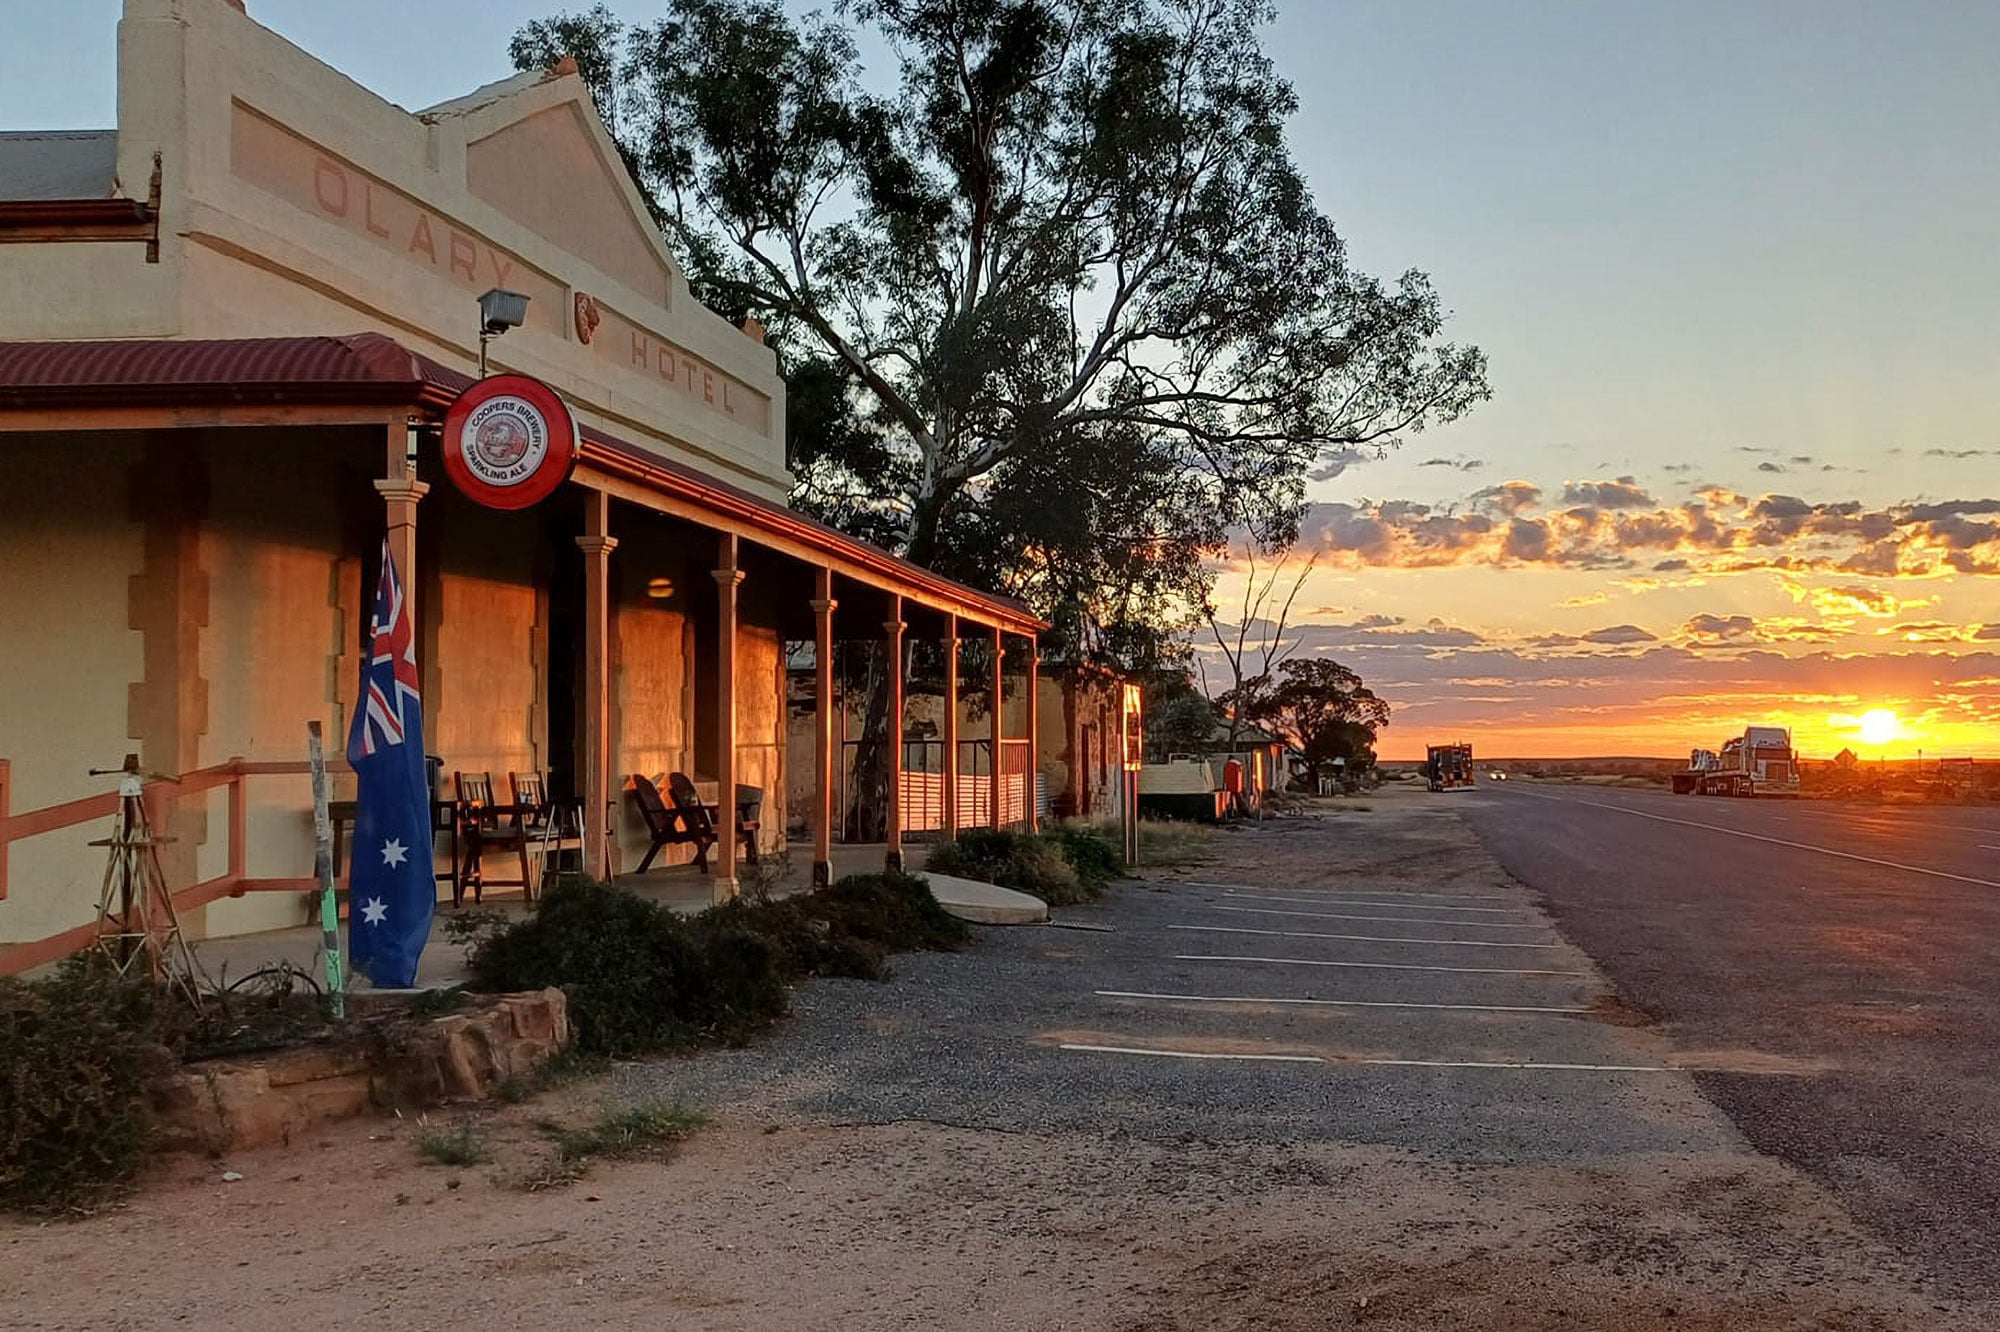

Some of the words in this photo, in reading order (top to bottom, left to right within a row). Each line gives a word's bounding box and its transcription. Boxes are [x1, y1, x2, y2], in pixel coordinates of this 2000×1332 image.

[314, 157, 513, 289] OLARY
[631, 331, 735, 414] HOTEL
[471, 401, 515, 427] COOPERS
[517, 404, 543, 450] BREWERY
[465, 444, 508, 480] SPARKLING
[510, 463, 528, 479] ALE
